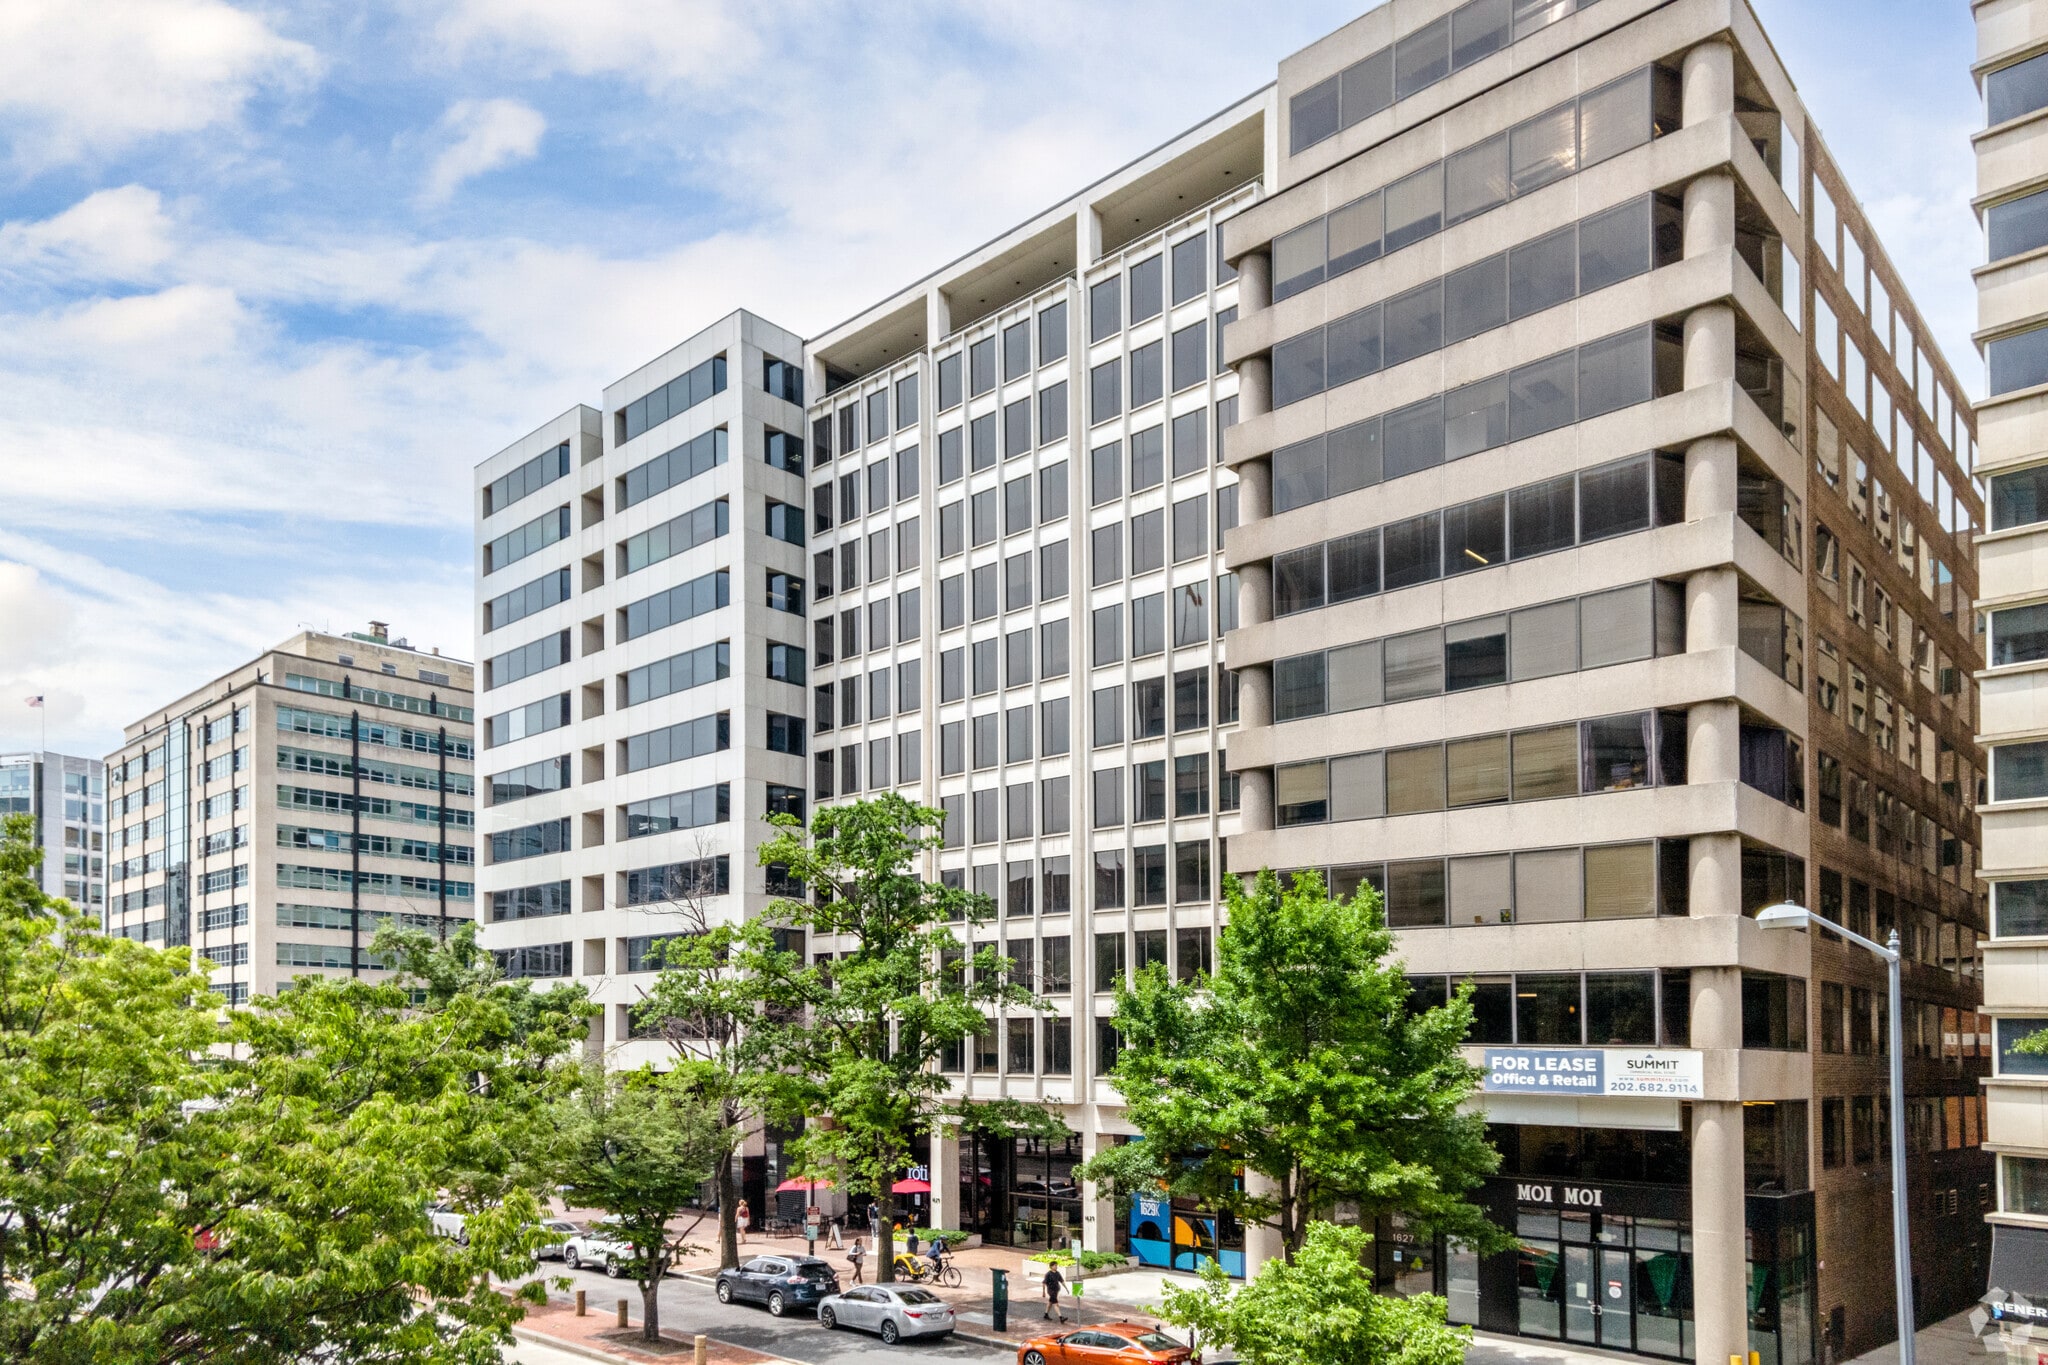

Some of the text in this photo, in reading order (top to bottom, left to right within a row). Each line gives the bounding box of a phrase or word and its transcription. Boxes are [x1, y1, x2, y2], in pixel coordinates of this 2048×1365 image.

[1491, 1056, 1597, 1072] FOR LEASE
[1627, 1059, 1679, 1070] SUMMIT
[1492, 1072, 1597, 1087] Office & Retail
[1610, 1082, 1698, 1093] 202.682.9114
[1517, 1183, 1602, 1206] MOI MOI
[1392, 1233, 1415, 1243] 1627
